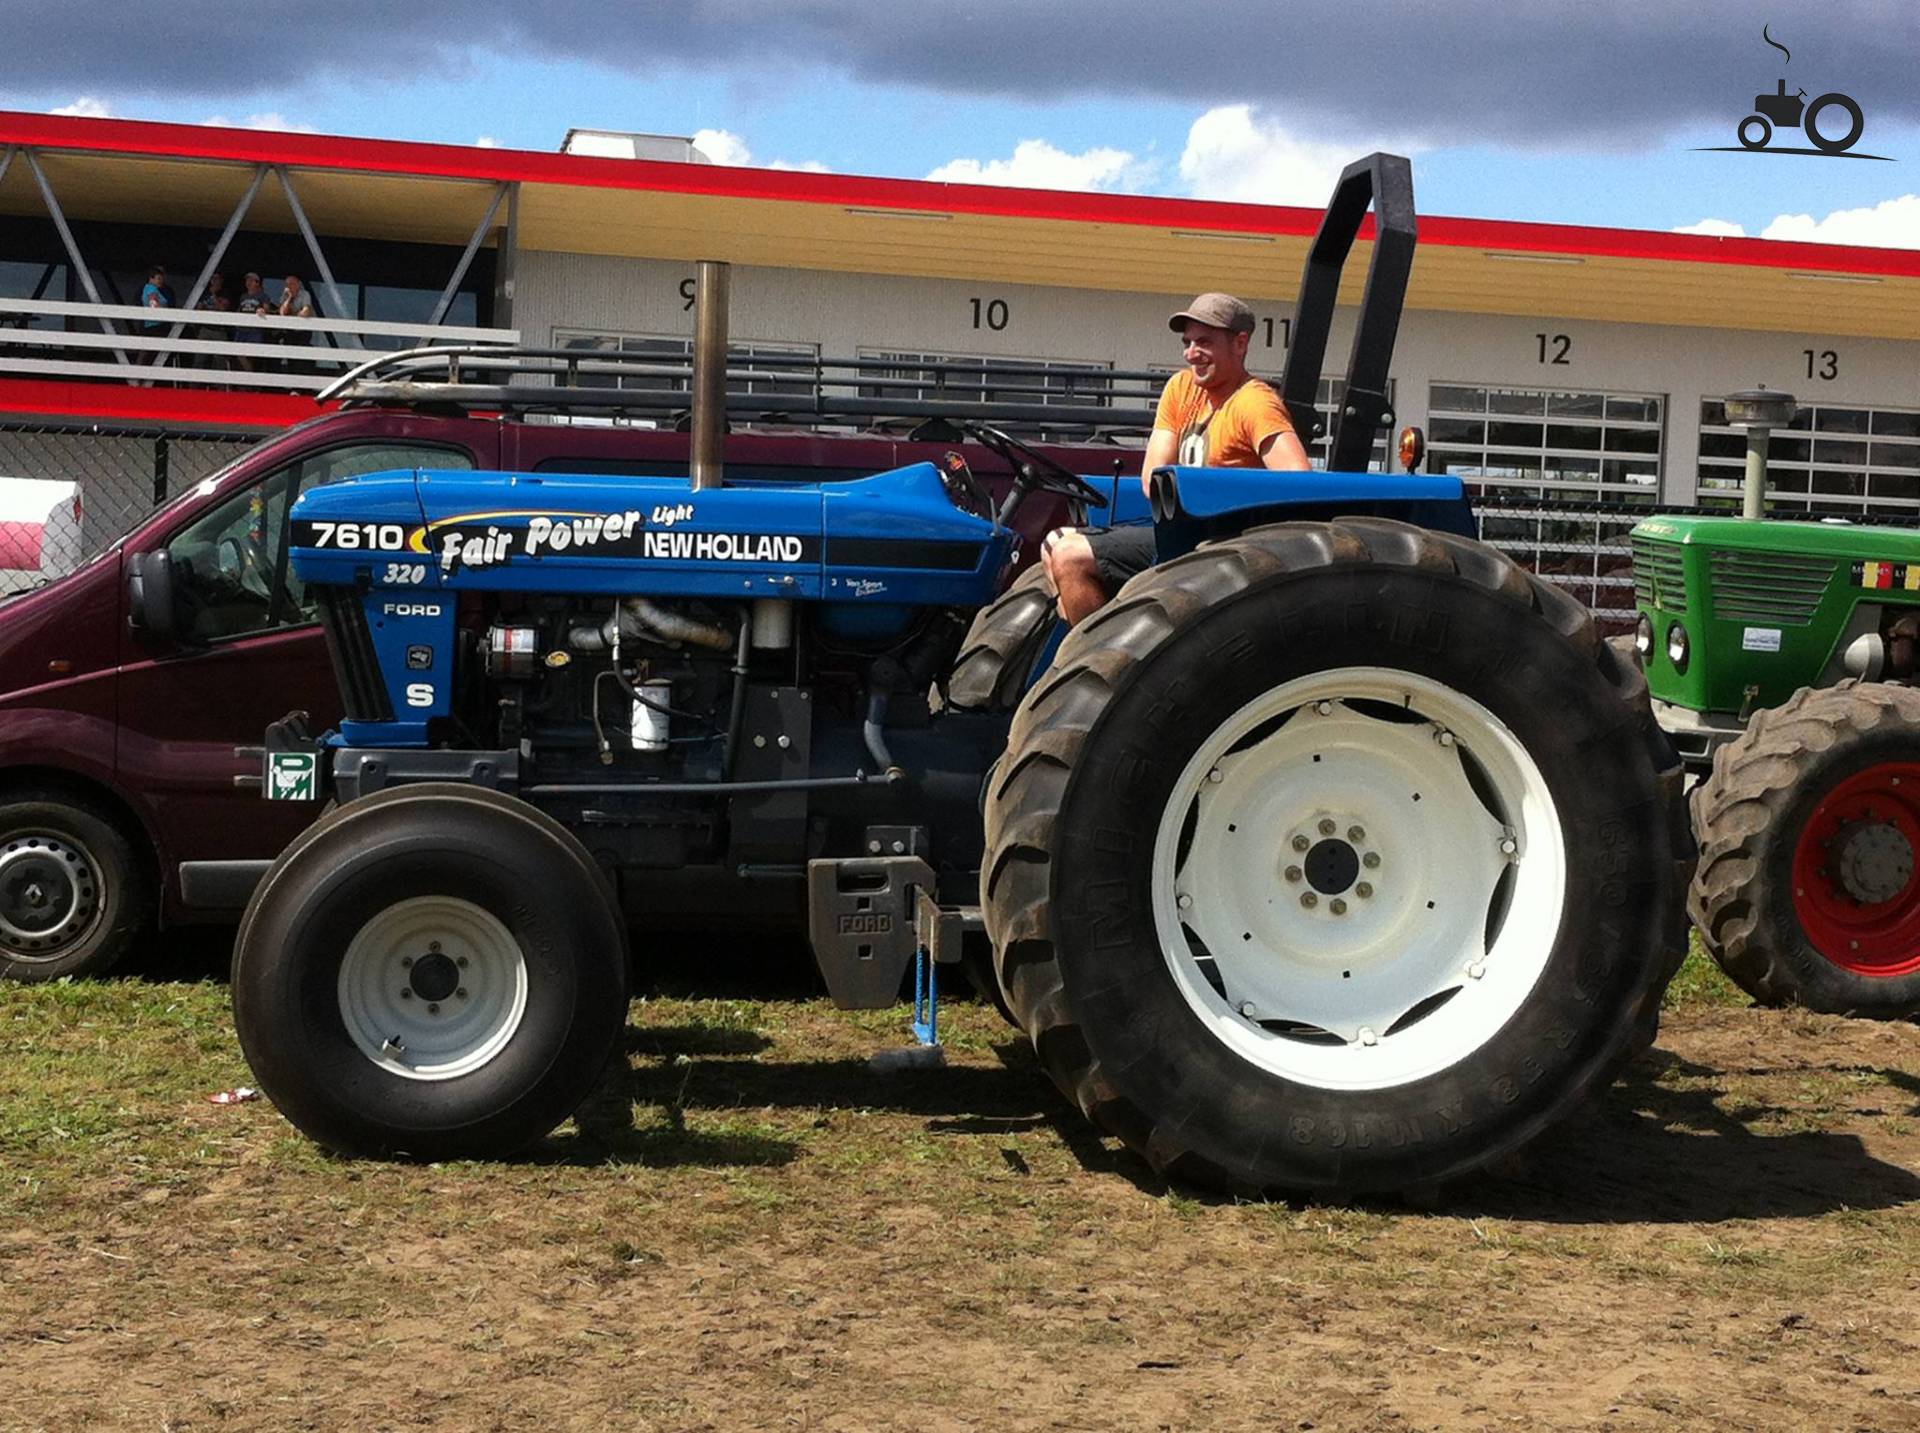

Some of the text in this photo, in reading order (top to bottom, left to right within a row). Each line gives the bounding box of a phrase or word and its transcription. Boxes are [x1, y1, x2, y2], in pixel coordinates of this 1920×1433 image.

[970, 297, 1010, 331] 10
[1263, 317, 1291, 349] 11
[1535, 333, 1572, 364] 12
[1803, 350, 1839, 380] 13
[651, 503, 695, 527] Light
[311, 521, 404, 550] 7610
[440, 509, 642, 571] Fair Power
[644, 532, 803, 562] NEW HOLLAND
[382, 563, 427, 585] 320
[383, 603, 442, 617] FORD
[406, 683, 435, 708] S
[840, 914, 893, 936] FORD
